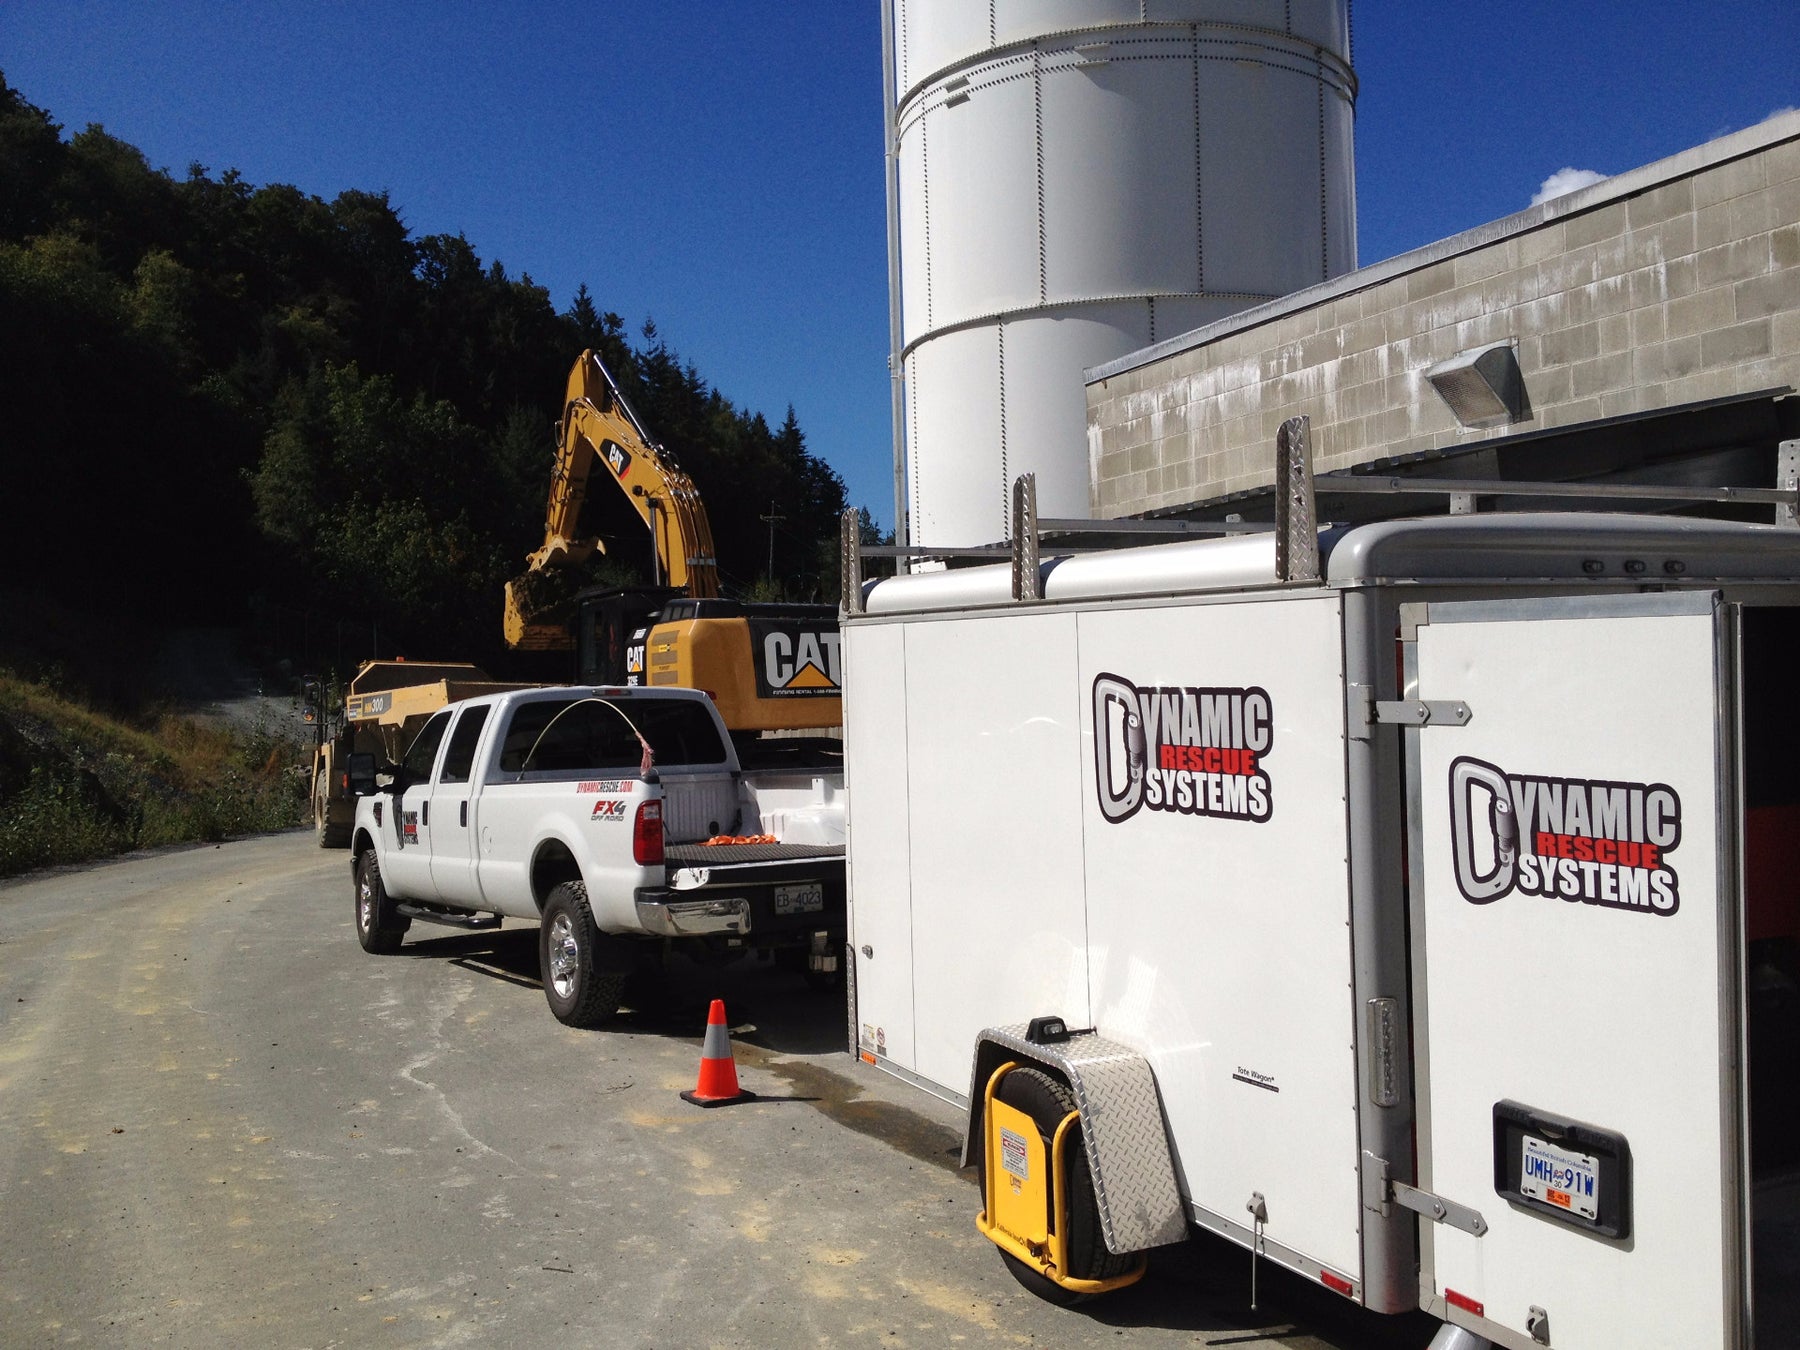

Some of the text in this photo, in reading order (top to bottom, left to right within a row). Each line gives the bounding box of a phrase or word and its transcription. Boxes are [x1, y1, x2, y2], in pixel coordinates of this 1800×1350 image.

[627, 645, 645, 673] CAT
[764, 632, 842, 689] CAT
[1160, 743, 1257, 776] RESCUE
[576, 780, 633, 794] DYNAMICRESCUE.COM
[1145, 767, 1270, 818] SYSTEMS
[592, 800, 627, 815] FX4
[1536, 831, 1660, 870] RESCUE
[1517, 852, 1676, 911] SYSTEMS
[1525, 1154, 1554, 1183] UMH
[1527, 1146, 1592, 1173] Beautiful British Columbia
